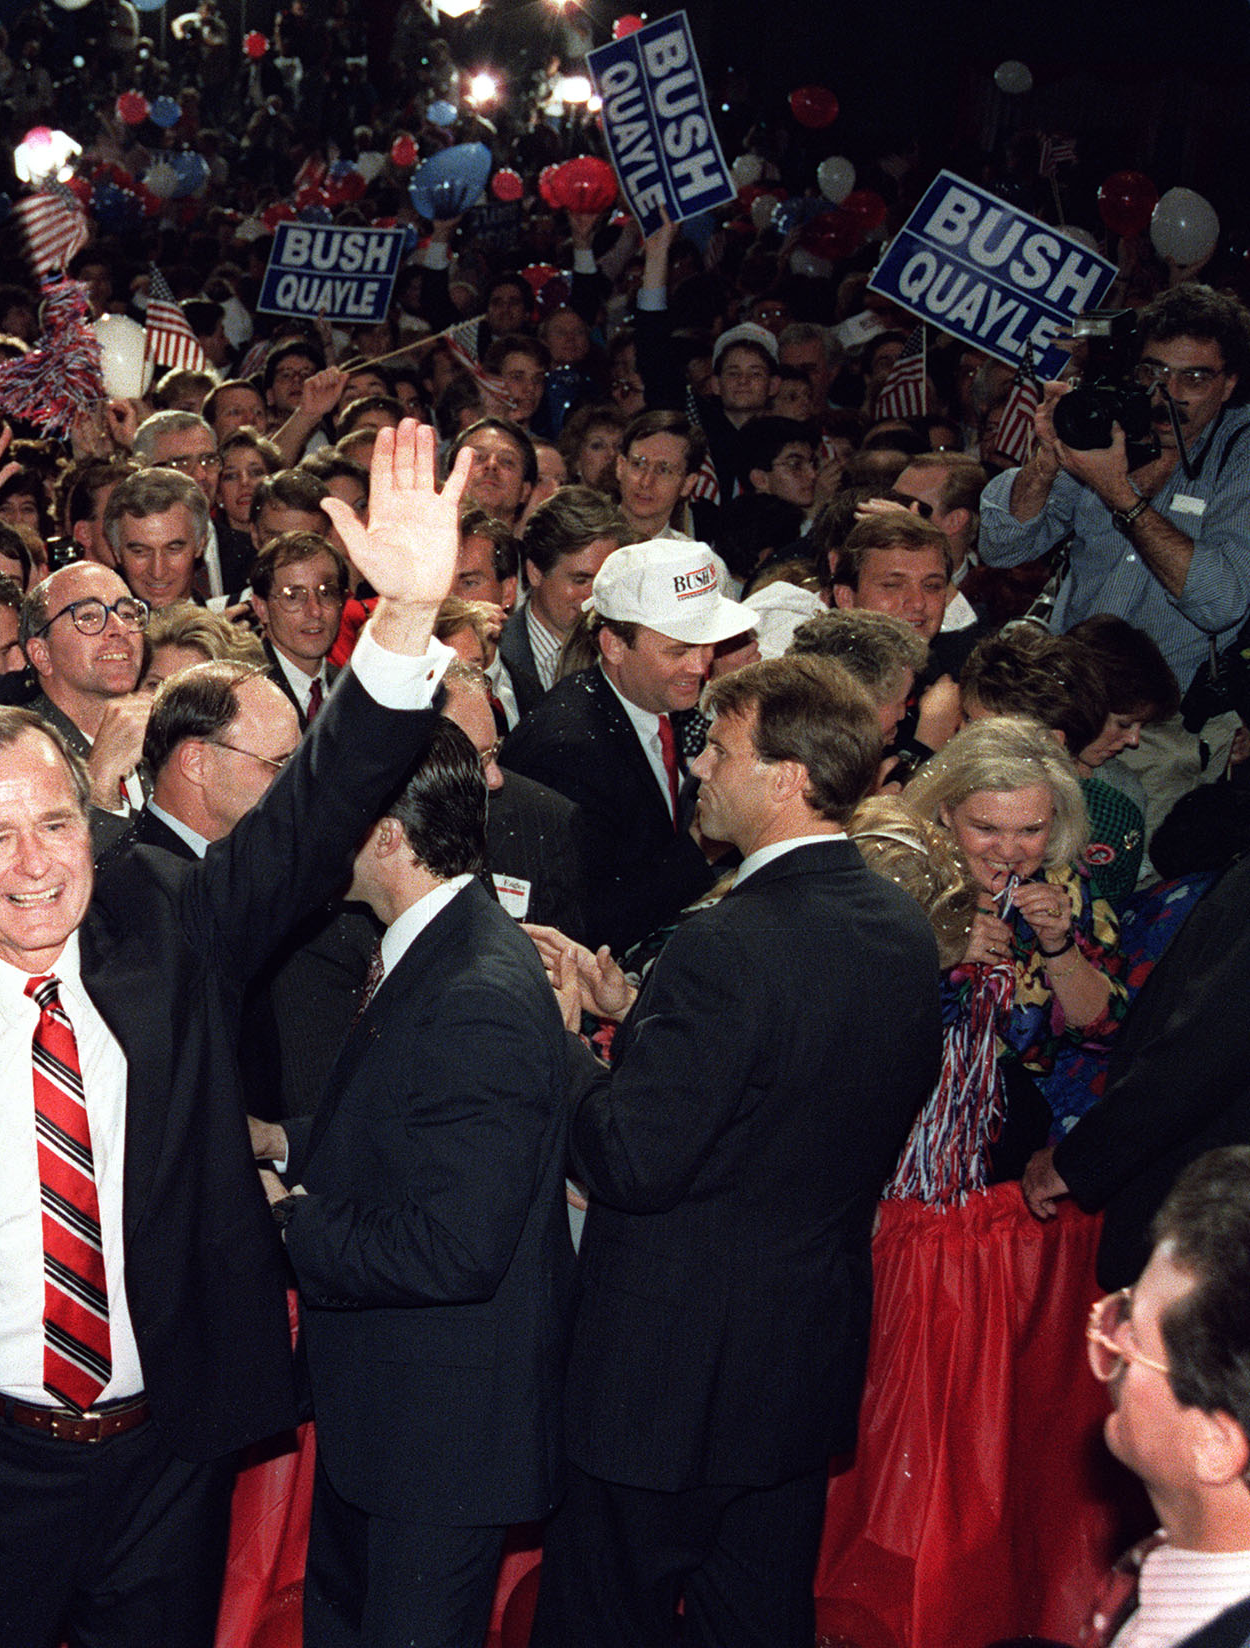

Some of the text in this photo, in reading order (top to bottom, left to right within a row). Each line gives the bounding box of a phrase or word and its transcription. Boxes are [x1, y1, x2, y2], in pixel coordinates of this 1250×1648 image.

[600, 60, 667, 217] QUAYLE
[643, 29, 724, 201] BUSH
[275, 273, 380, 316] QUAYLE
[280, 228, 393, 272] BUSH
[923, 185, 1103, 315] BUSH
[898, 251, 1061, 365] QUAYLE
[673, 569, 710, 593] BUSH
